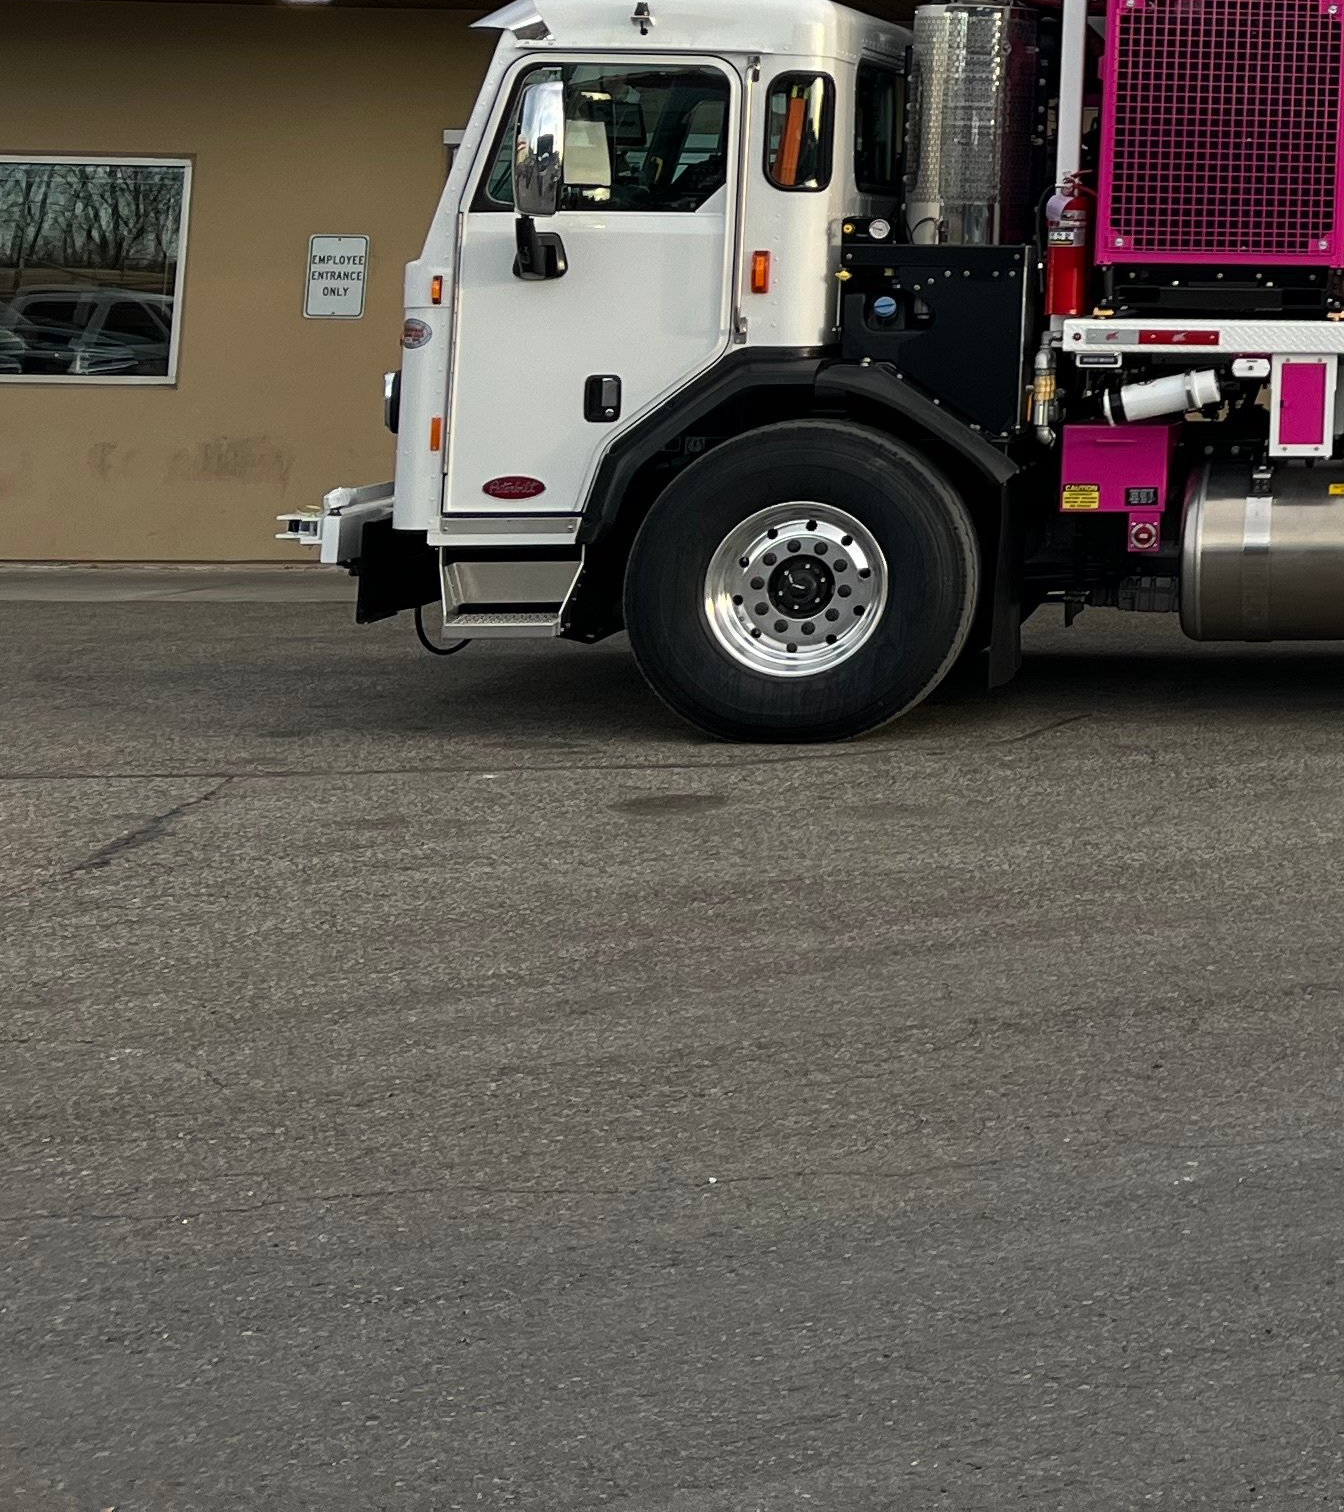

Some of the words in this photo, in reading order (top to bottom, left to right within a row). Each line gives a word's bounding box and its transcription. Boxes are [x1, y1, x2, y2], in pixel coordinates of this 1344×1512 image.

[311, 255, 364, 265] EMPLOYEE
[311, 271, 363, 281] ENTRANCE
[322, 287, 350, 297] ONLY
